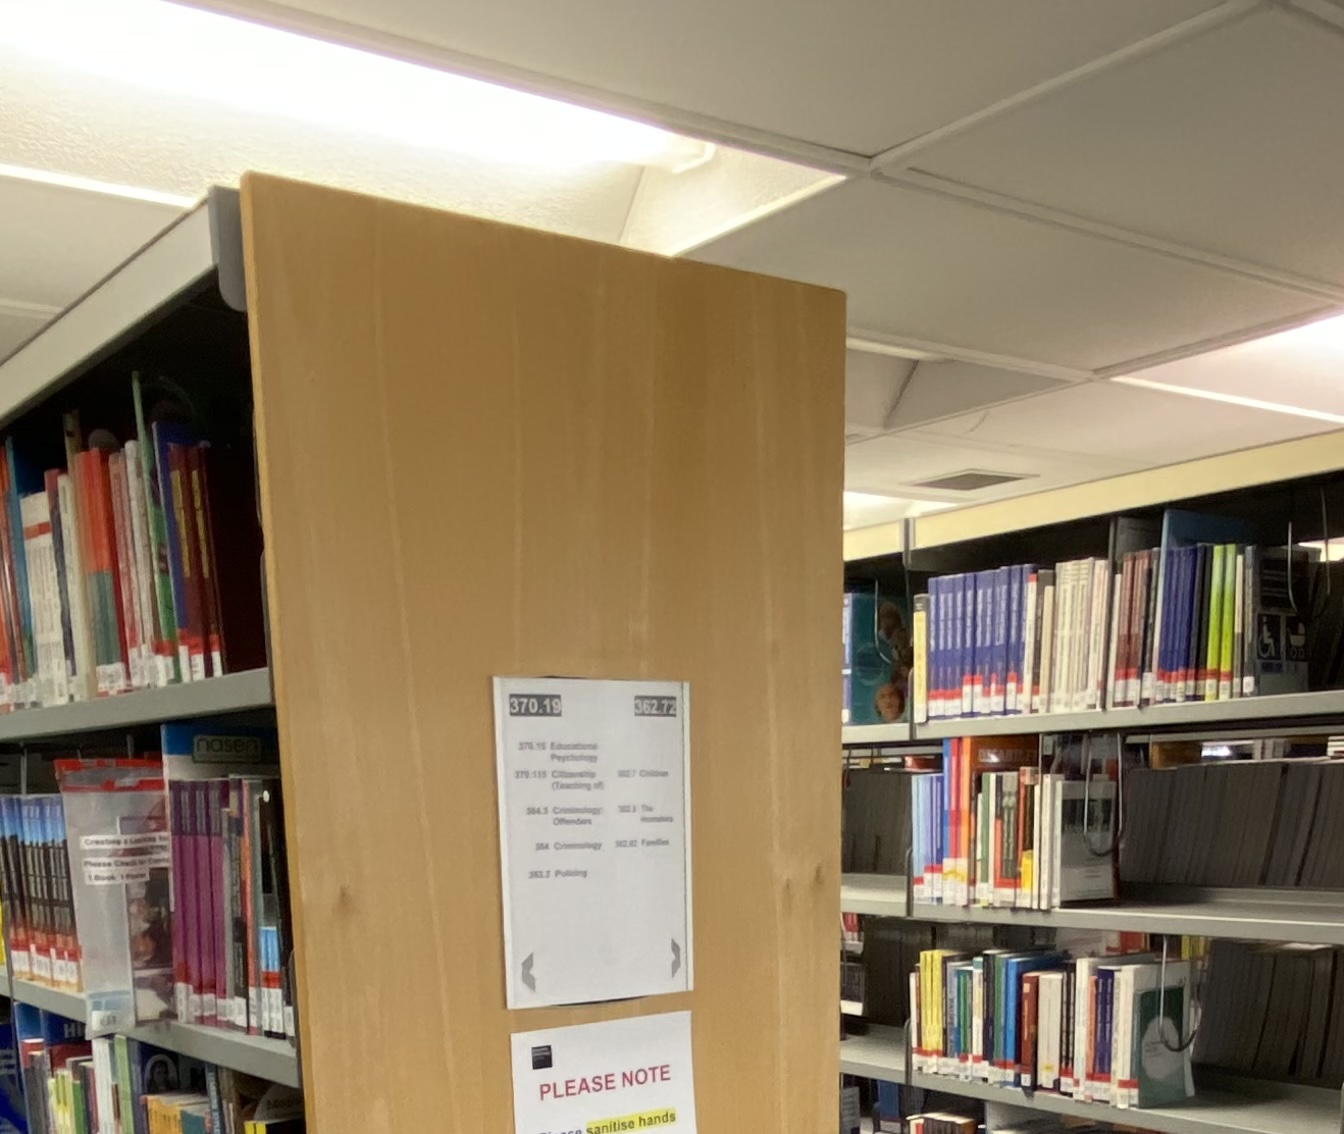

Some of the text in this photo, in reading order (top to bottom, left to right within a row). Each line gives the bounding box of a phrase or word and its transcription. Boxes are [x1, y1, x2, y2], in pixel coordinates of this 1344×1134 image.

[510, 697, 561, 714] 370.19
[635, 699, 676, 715] 362.72
[540, 1064, 671, 1101] PLEASE NOTE
[638, 1110, 676, 1128] hands
